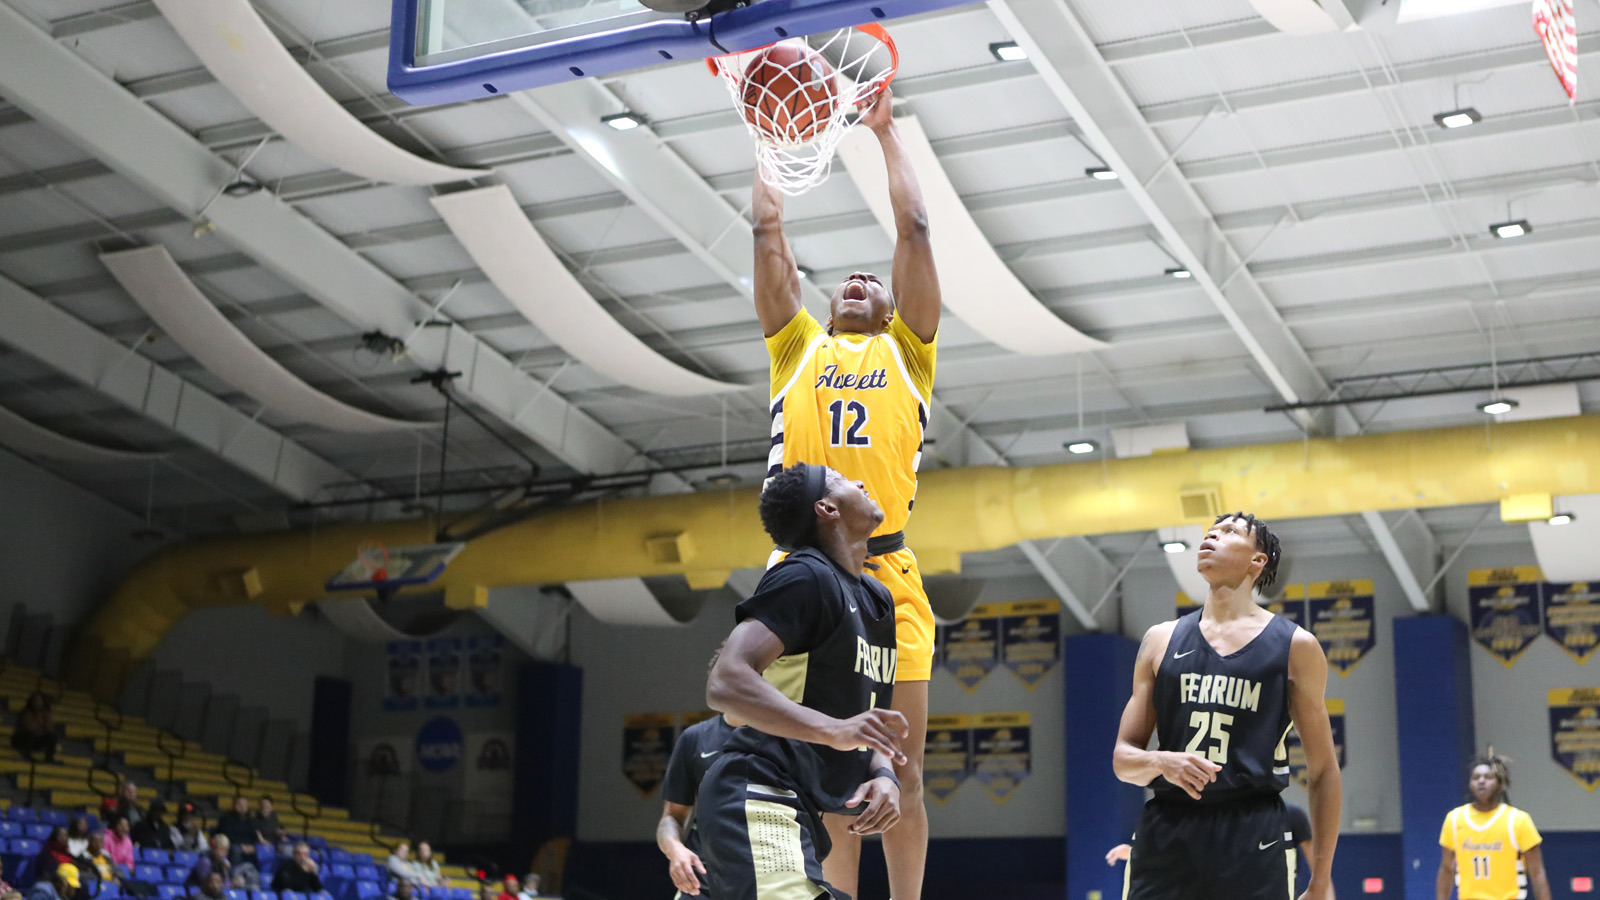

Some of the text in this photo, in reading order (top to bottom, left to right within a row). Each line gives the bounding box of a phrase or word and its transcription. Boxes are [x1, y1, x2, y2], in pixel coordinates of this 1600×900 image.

[828, 398, 872, 448] 12
[854, 635, 897, 686] FERRU
[1180, 672, 1262, 713] FERRUM
[1184, 710, 1235, 765] 25
[1472, 854, 1491, 880] 11
